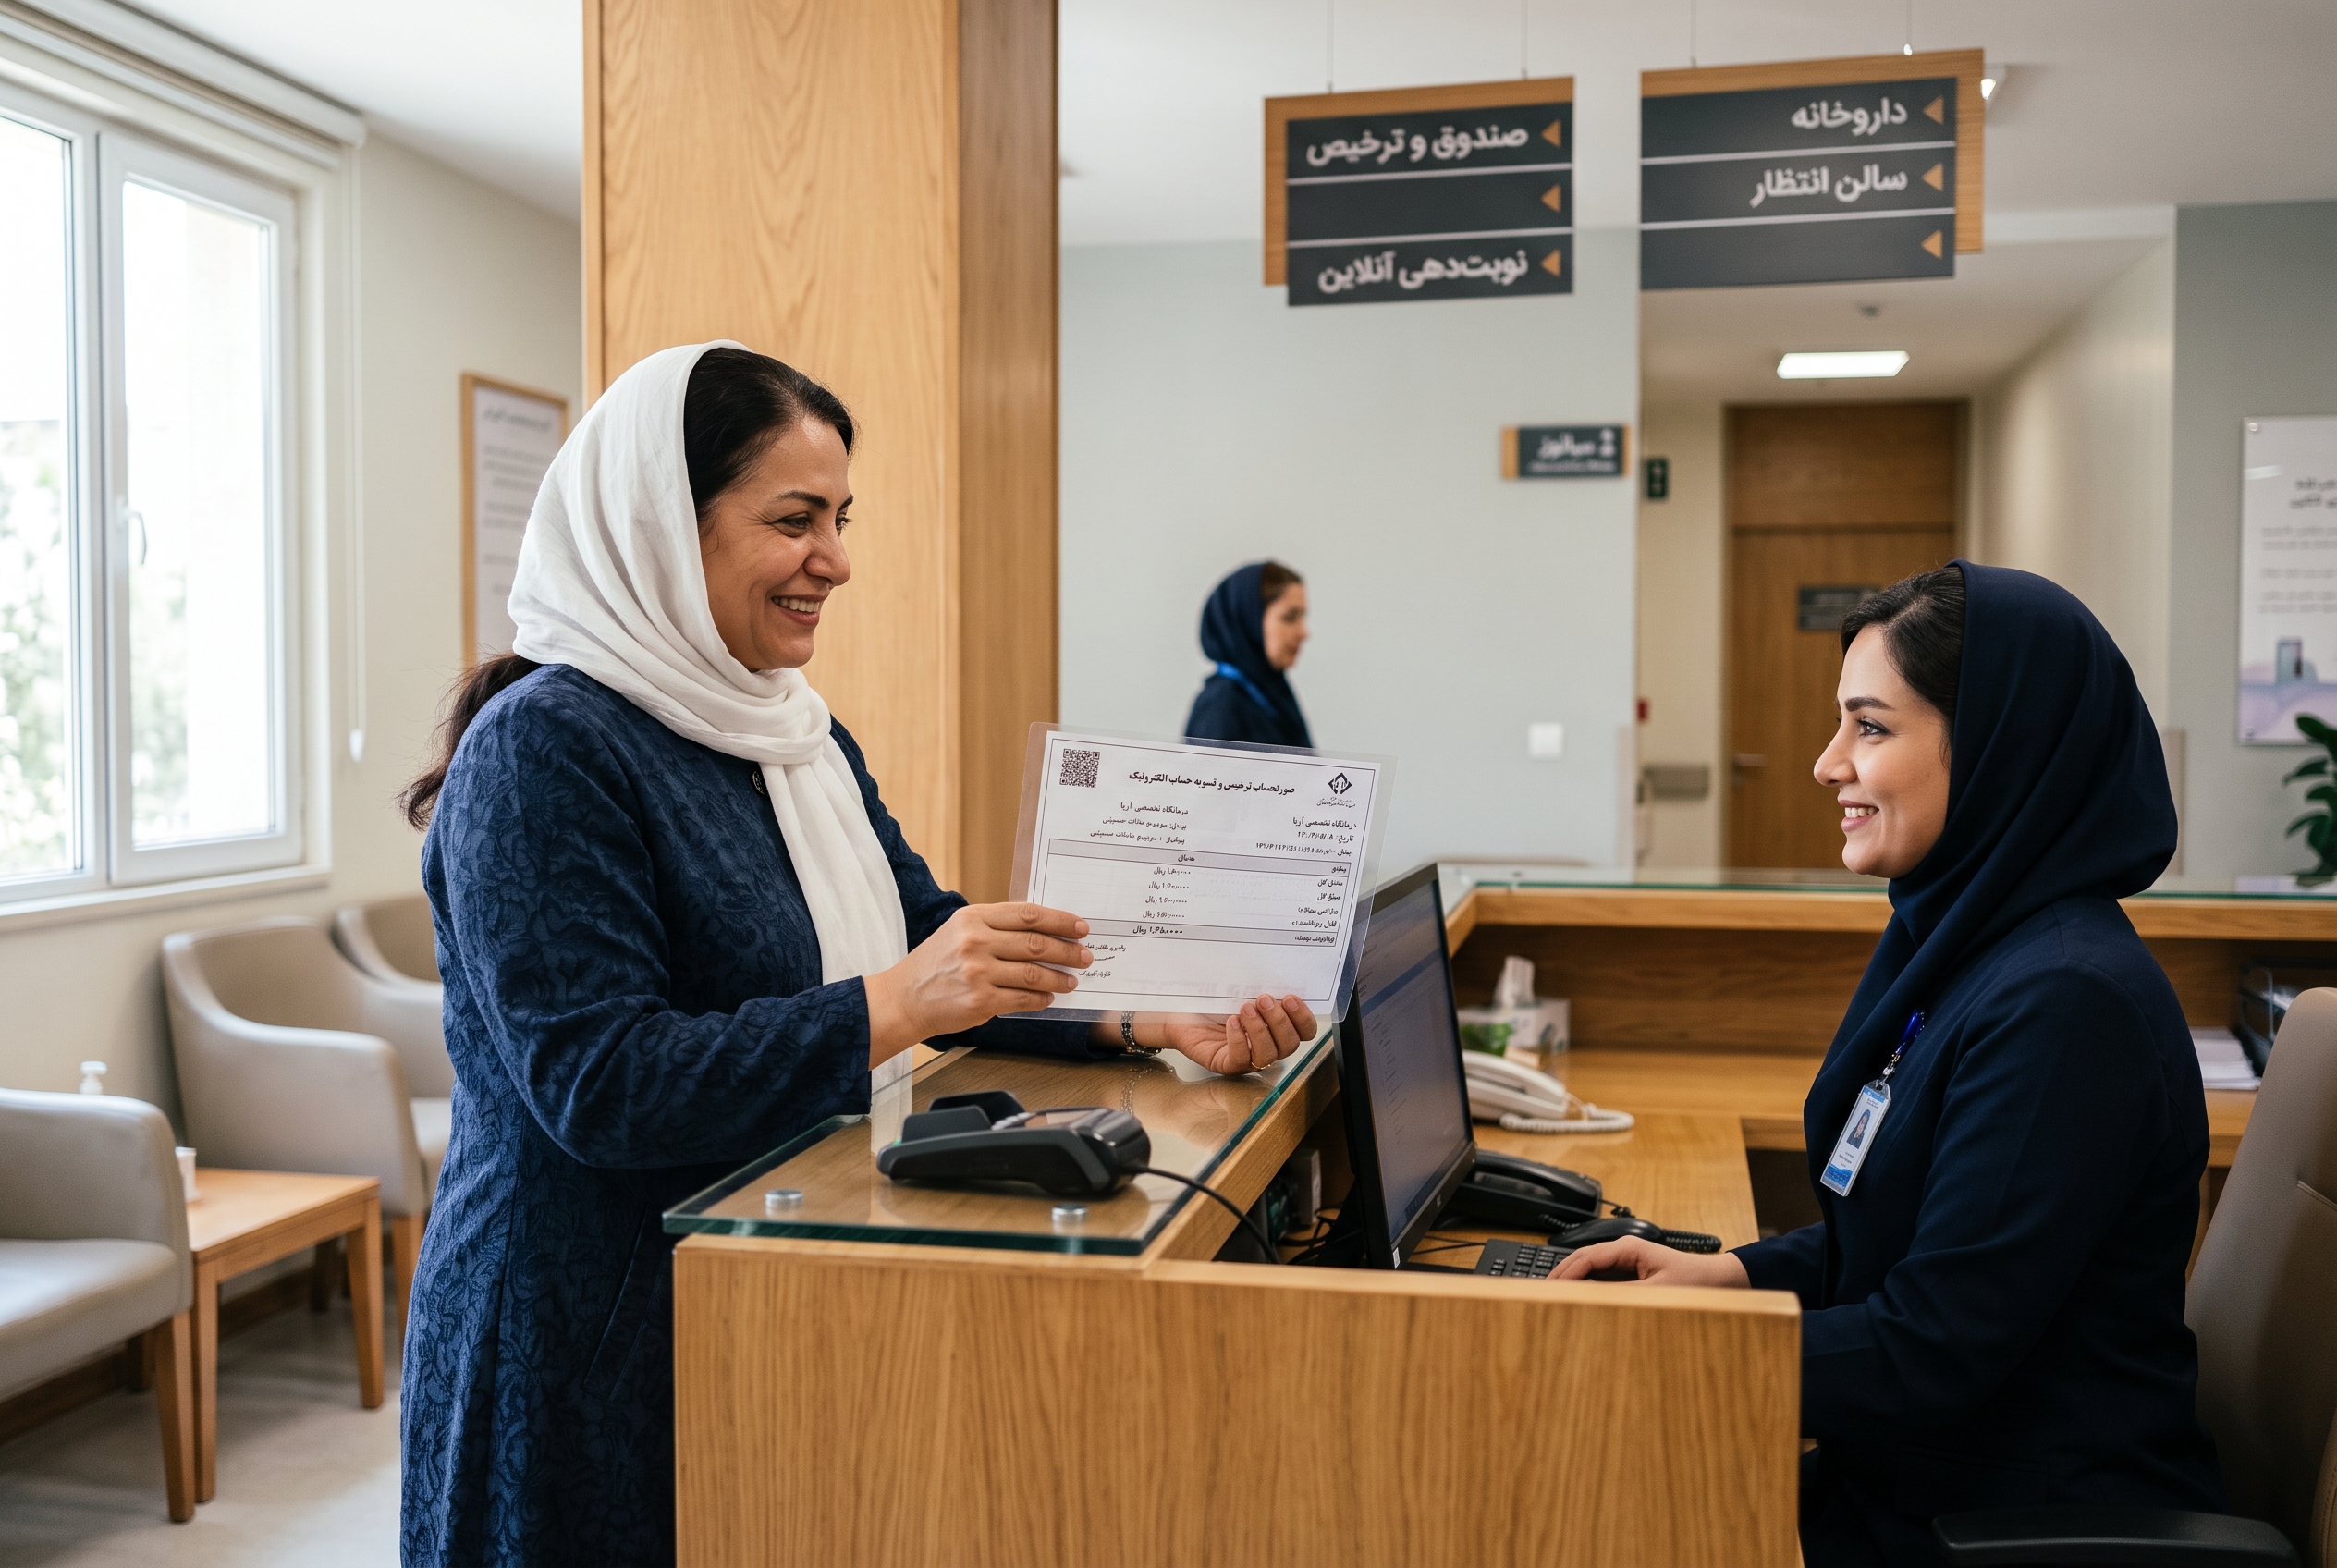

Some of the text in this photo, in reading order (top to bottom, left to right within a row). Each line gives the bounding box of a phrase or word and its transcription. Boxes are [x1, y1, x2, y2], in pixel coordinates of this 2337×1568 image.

[1791, 96, 1908, 137] داروخانه
[1305, 124, 1529, 167] صندوق و ترخیص
[1748, 163, 1909, 209] سالن انتظار
[1317, 250, 1397, 294] آنلاین
[1168, 775, 1193, 786] حساب
